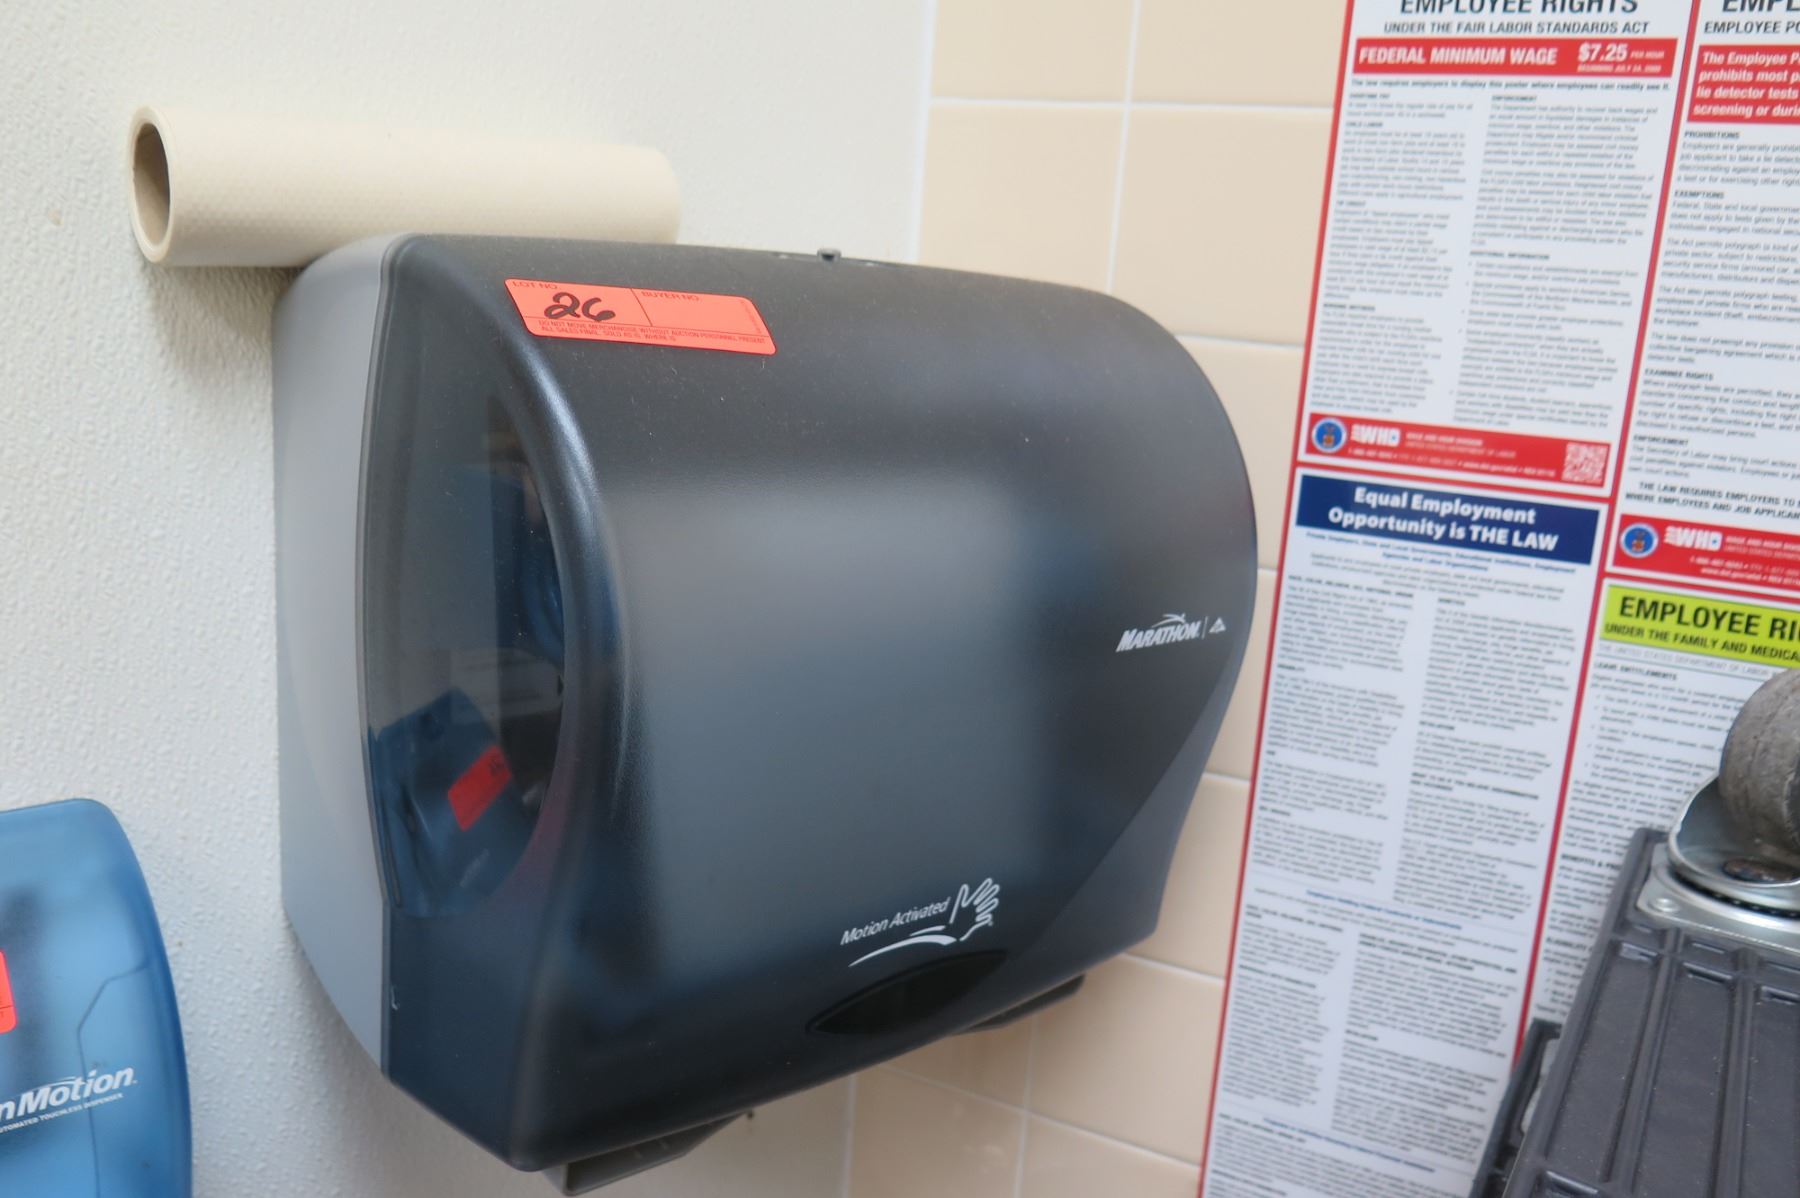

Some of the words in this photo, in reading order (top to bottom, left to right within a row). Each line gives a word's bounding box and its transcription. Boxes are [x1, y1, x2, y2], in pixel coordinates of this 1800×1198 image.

[1384, 21, 1425, 33] UNDER
[1430, 22, 1452, 32] THE
[1456, 22, 1486, 32] FAIR
[1488, 22, 1533, 32] LABOR
[1536, 22, 1618, 32] STANDARDS
[1621, 22, 1648, 32] ACT
[1703, 21, 1780, 32] EMPLOYEE
[1358, 47, 1426, 64] FEDERAL
[1429, 47, 1506, 64] MINIMUM
[1509, 48, 1558, 65] WAGE
[1577, 43, 1628, 61] $7.25
[1702, 52, 1725, 65] The
[1727, 52, 1788, 67] Employee
[1698, 69, 1754, 84] prohibits
[1756, 70, 1789, 82] most
[1789, 71, 1800, 84] p
[1695, 86, 1712, 98] lie
[1714, 86, 1765, 99] detector
[1768, 87, 1799, 99] tests
[1692, 104, 1753, 119] screening
[1756, 106, 1770, 116] or
[544, 291, 616, 322] 26
[1638, 482, 1654, 490] THE
[1657, 484, 1677, 492] LAW
[1678, 487, 1723, 498] REQUIRES
[1725, 492, 1780, 504] EMPLOYERS
[1783, 497, 1795, 507] TO
[1354, 486, 1407, 509] Equal
[1411, 494, 1536, 525] Employment
[1328, 507, 1446, 540] Opportunity
[1449, 521, 1466, 540] is
[1470, 524, 1509, 546] THE
[1512, 530, 1559, 551] LAW
[1619, 596, 1762, 637] EMPLOYEE
[1768, 616, 1800, 642] RI
[1115, 620, 1201, 653] MARATHON
[1603, 622, 1645, 637] UNDER
[1648, 629, 1669, 641] THE
[1672, 633, 1717, 648] FAMILY
[1720, 640, 1748, 653] AND
[840, 918, 889, 946] Motion
[889, 896, 951, 928] Activated
